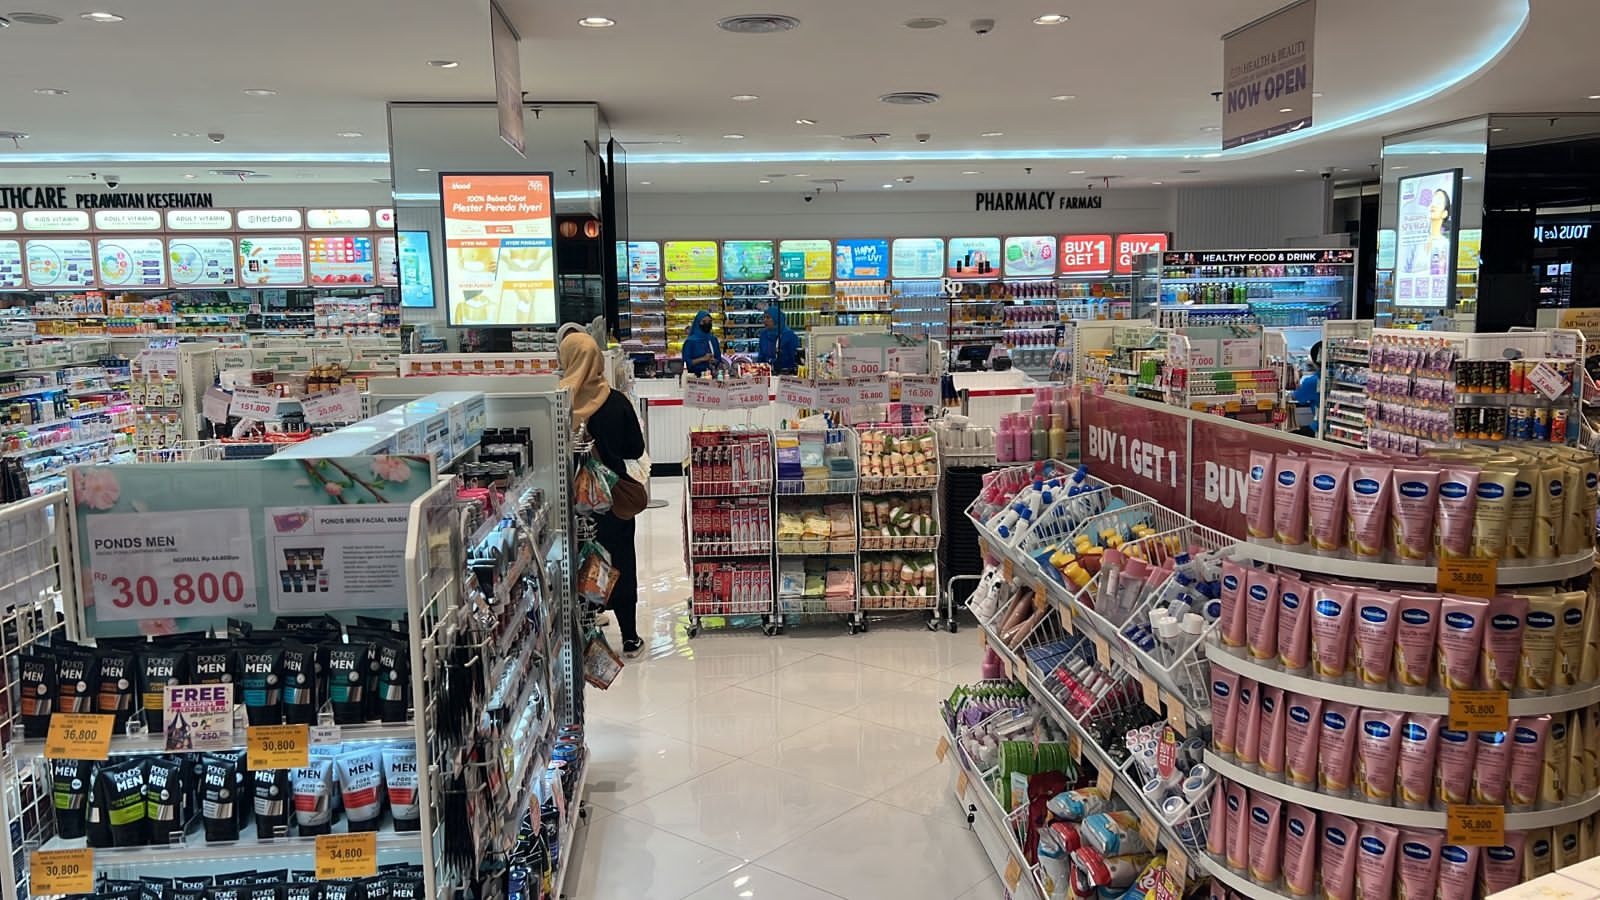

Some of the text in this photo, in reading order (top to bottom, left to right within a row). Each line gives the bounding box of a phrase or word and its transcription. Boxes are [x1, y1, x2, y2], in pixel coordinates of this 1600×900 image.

[1227, 82, 1261, 114] NOW
[1265, 64, 1307, 101] OPEN
[0, 187, 213, 209] THCARE PERAWATAN KESEHATAN
[976, 191, 1102, 211] PHARMACY FARMASI
[519, 203, 543, 213] Nyeri
[1065, 241, 1094, 254] BUY
[1094, 240, 1105, 264] 1
[1120, 242, 1149, 254] BUY
[1065, 253, 1094, 265] GET
[1203, 253, 1316, 262] HEALTHY FOOD & DRINK
[851, 364, 879, 373] 9.000
[1088, 425, 1177, 488] BUY 1 GET 1
[1205, 461, 1250, 514] BUY
[94, 536, 175, 549] PONDS MEN
[94, 571, 244, 609] Rp 30.800
[284, 660, 302, 671] MEN
[330, 660, 354, 669] MEN
[380, 655, 395, 668] MEN
[60, 668, 83, 679] MEN
[101, 666, 124, 677] MEN
[146, 666, 173, 677] MEN
[197, 663, 226, 673] MEN
[245, 663, 272, 673] MEN
[23, 671, 43, 682] MEN
[171, 687, 226, 702] FREE
[55, 766, 77, 777] MEN
[349, 762, 374, 776] MEN
[392, 763, 417, 772] MEN
[254, 771, 275, 784] MEN
[297, 768, 321, 779] MEN
[116, 774, 143, 792] MEN
[149, 774, 167, 788] MEN
[205, 774, 225, 787] MEN
[326, 892, 346, 900] MEN
[367, 887, 389, 898] MEN
[393, 889, 414, 898] MEN
